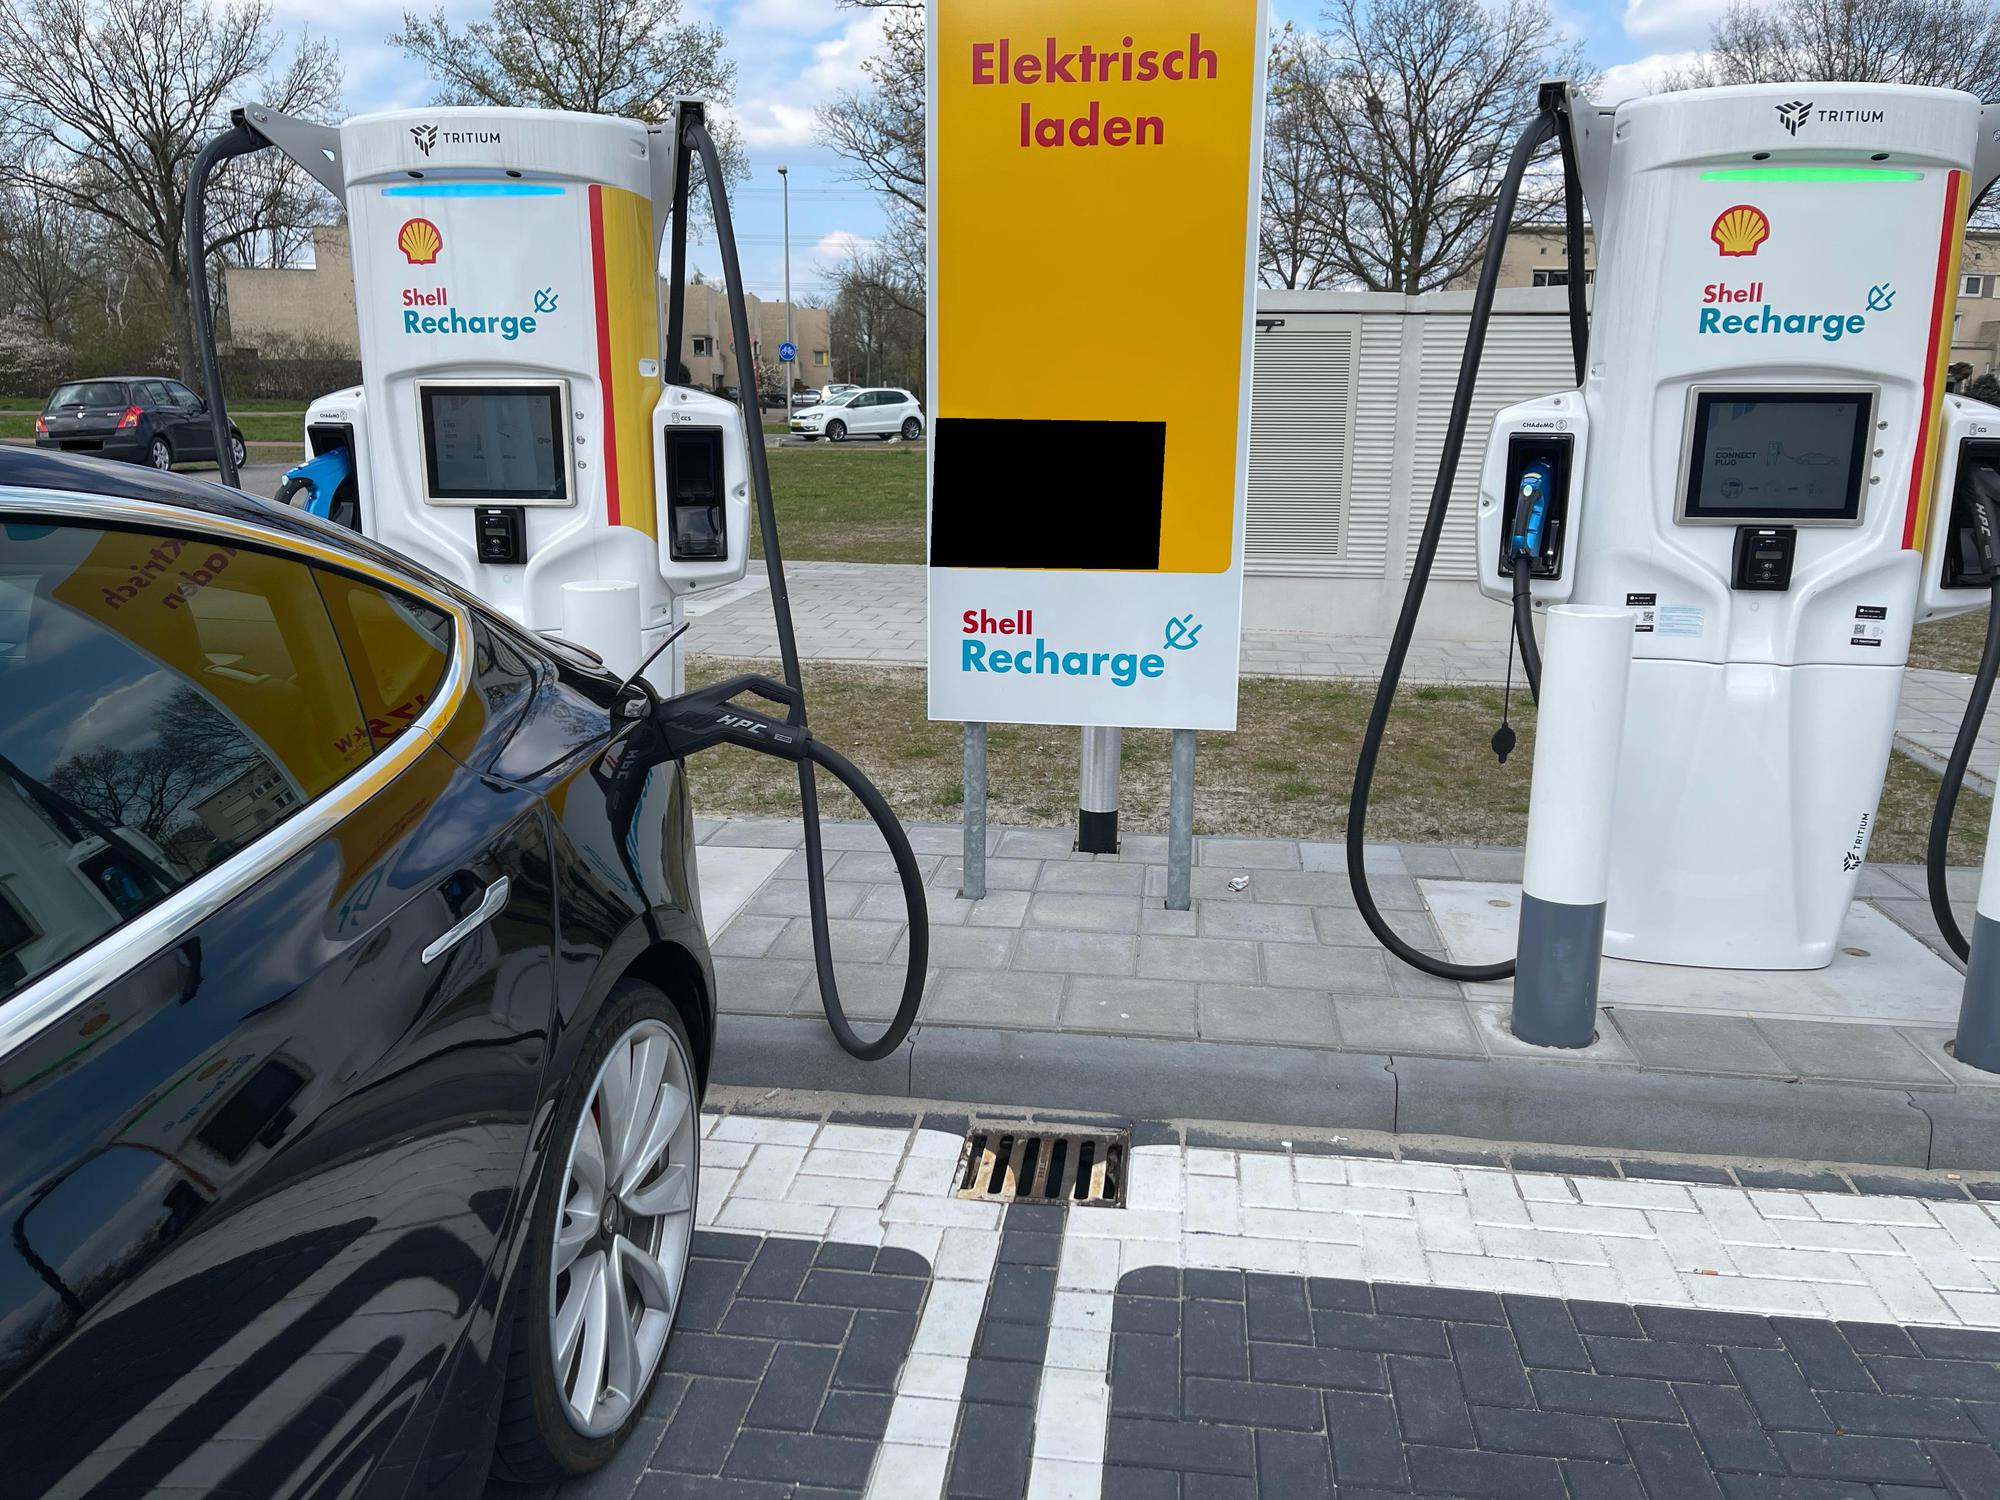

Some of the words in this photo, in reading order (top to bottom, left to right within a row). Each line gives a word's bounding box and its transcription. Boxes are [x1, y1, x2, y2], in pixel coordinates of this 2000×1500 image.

[972, 32, 1218, 85] Elektrisch
[1020, 100, 1165, 148] laden
[1818, 110, 1885, 123] TRITIUM
[442, 132, 501, 144] TRITIUM
[402, 287, 448, 307] Shell
[1702, 282, 1764, 304] Shell
[403, 307, 537, 341] Recharge
[1698, 304, 1866, 342] Recharge
[1715, 451, 1757, 459] CONNECT
[1715, 459, 1738, 467] PLUG
[1975, 502, 1992, 537] HPC
[962, 608, 1033, 635] Shell
[961, 638, 1165, 687] Recharge
[715, 714, 768, 735] HPC
[1852, 812, 1870, 850] TRITIUM
